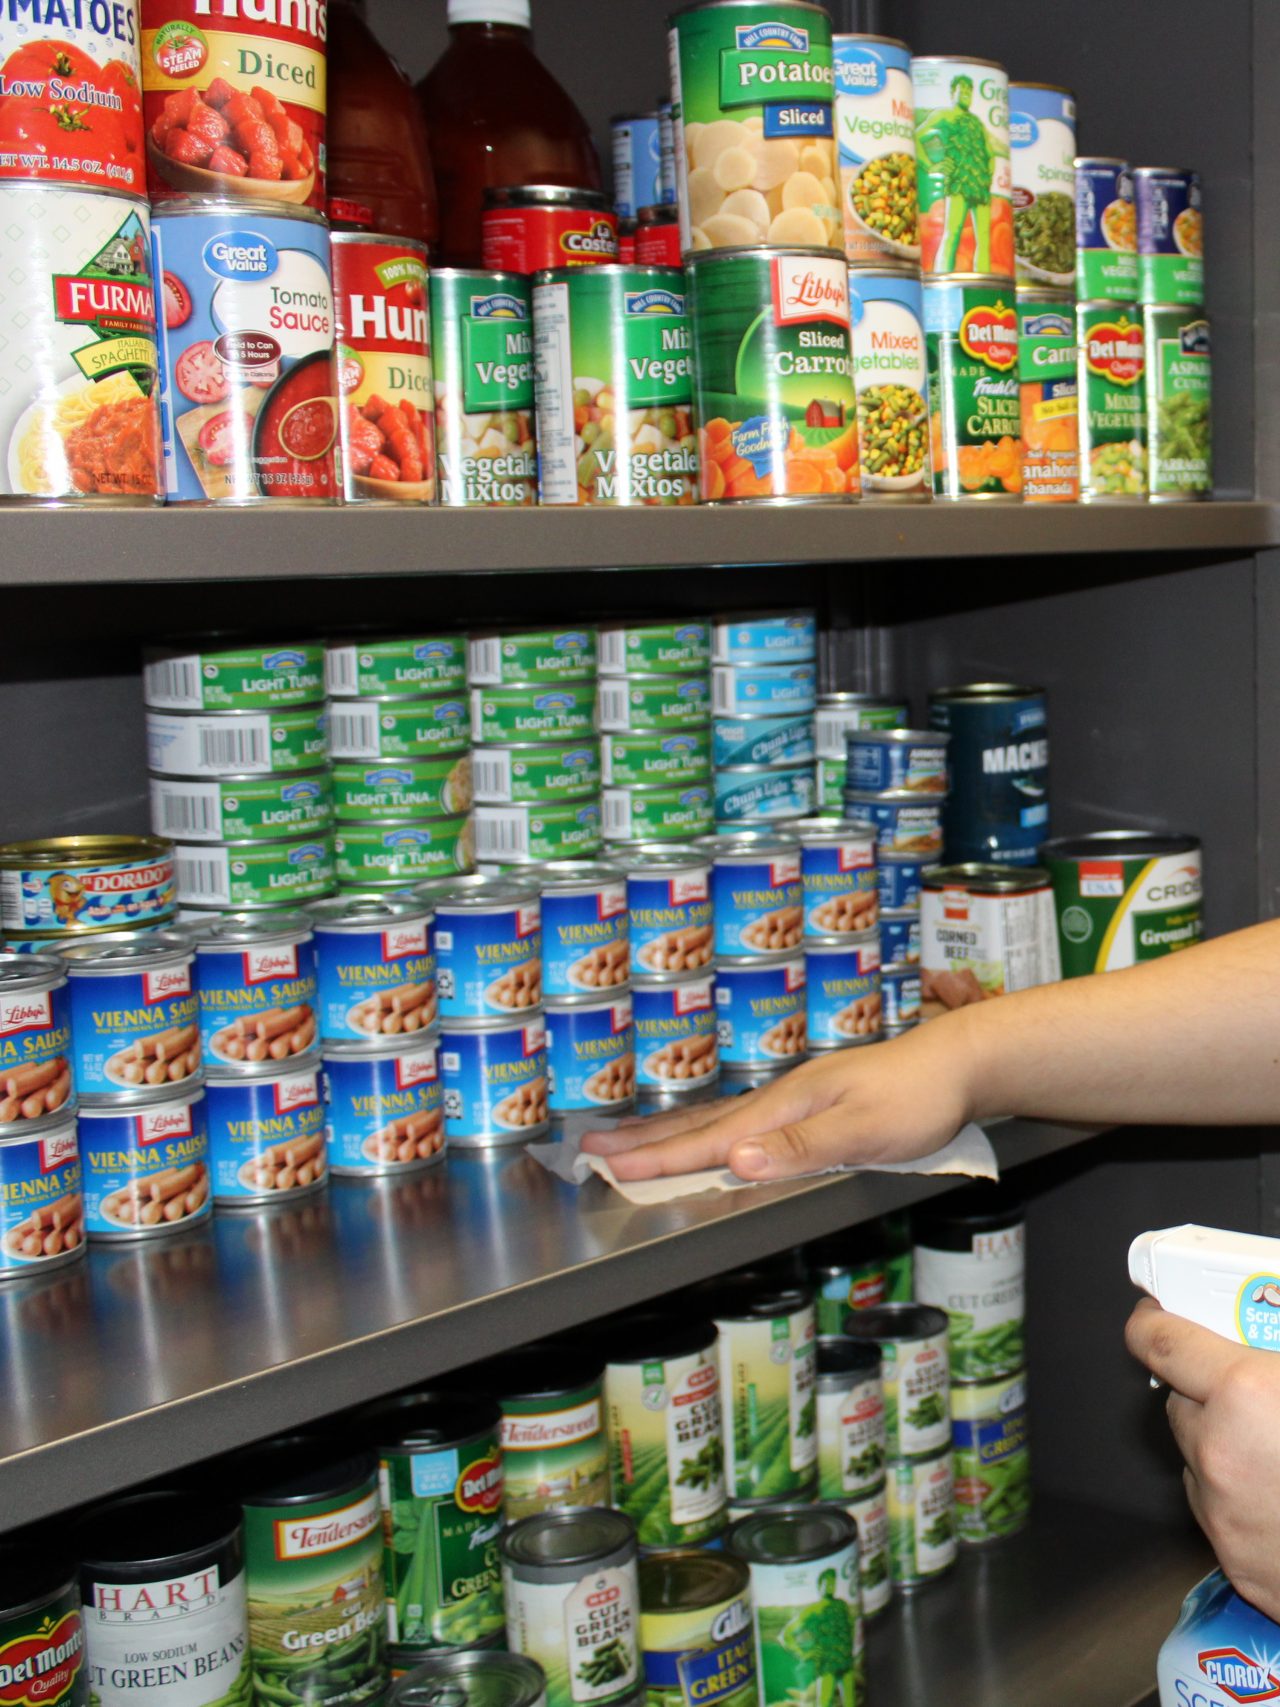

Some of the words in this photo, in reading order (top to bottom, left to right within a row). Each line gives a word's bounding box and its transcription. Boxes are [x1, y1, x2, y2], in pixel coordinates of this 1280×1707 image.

[0, 0, 135, 46] MATOES
[163, 49, 203, 69] STEAM
[170, 60, 200, 74] PEELED
[238, 49, 316, 89] Diced
[0, 75, 45, 97] Low
[50, 79, 123, 112] Sodium
[779, 110, 824, 126] Sliced
[20, 155, 50, 169] WT.
[53, 157, 79, 171] 14.5
[82, 160, 105, 175] OZ.
[597, 225, 610, 238] La
[211, 242, 267, 262] Great
[228, 257, 267, 272] Value
[270, 286, 328, 310] Tomato
[269, 305, 330, 335] Sauce
[799, 331, 844, 350] Sliced
[871, 331, 919, 351] Mixed
[967, 323, 993, 342] Del
[246, 341, 256, 350] to
[256, 341, 274, 350] Can
[247, 350, 271, 360] Hours
[1088, 341, 1115, 359] Del
[952, 366, 986, 377] ADE
[732, 429, 761, 447] Farm
[594, 448, 698, 479] Vgetale
[597, 474, 684, 499] Mxtos
[395, 667, 434, 681] LIGHT
[242, 678, 285, 693] LIGHT
[515, 717, 555, 730] LIGHT
[416, 727, 451, 742] LIGHT
[346, 791, 387, 805] LIGHT
[389, 791, 430, 806] TUNA
[262, 808, 302, 824] LIGHT
[363, 853, 405, 868] LIGHT
[407, 849, 446, 865] TUNA
[93, 866, 165, 892] DORADO
[269, 870, 309, 888] LIGHT
[802, 873, 853, 888] VIENNA
[1087, 882, 1117, 894] USA
[732, 889, 784, 904] VIENNA
[630, 908, 685, 923] VIENNA
[558, 923, 612, 940] VIENNA
[935, 928, 978, 946] CORNED
[475, 941, 530, 960] VIENNA
[944, 945, 970, 960] BEEF
[156, 973, 188, 991] Libby's
[337, 964, 402, 981] VIENNA
[822, 978, 869, 994] VIENNA
[199, 987, 266, 1007] VIENNA
[4, 1003, 46, 1024] Libby's
[92, 1006, 166, 1029] VIENNA
[636, 1018, 690, 1034] VIENNA
[574, 1037, 626, 1056] VIENNA
[485, 1061, 536, 1081] VIENNA
[351, 1094, 415, 1111] VIENNA
[151, 1112, 186, 1133] Libby's
[227, 1119, 294, 1137] VIENNA
[88, 1150, 160, 1168] VIENNA
[1248, 1323, 1259, 1339] &
[463, 1475, 486, 1499] Del
[97, 1570, 216, 1611] HART
[99, 1594, 216, 1621] BRAND
[589, 1601, 620, 1621] CUT
[575, 1608, 631, 1636] GREEN
[282, 1623, 352, 1650] Green
[577, 1621, 631, 1647] BEANS
[111, 1662, 188, 1689] GREEN
[194, 1633, 245, 1678] BEANS
[124, 1652, 149, 1664] LOW
[152, 1642, 198, 1662] SODIUM
[0, 1657, 34, 1687] Del
[1205, 1660, 1272, 1690] CLOROX
[31, 1669, 70, 1695] Quality
